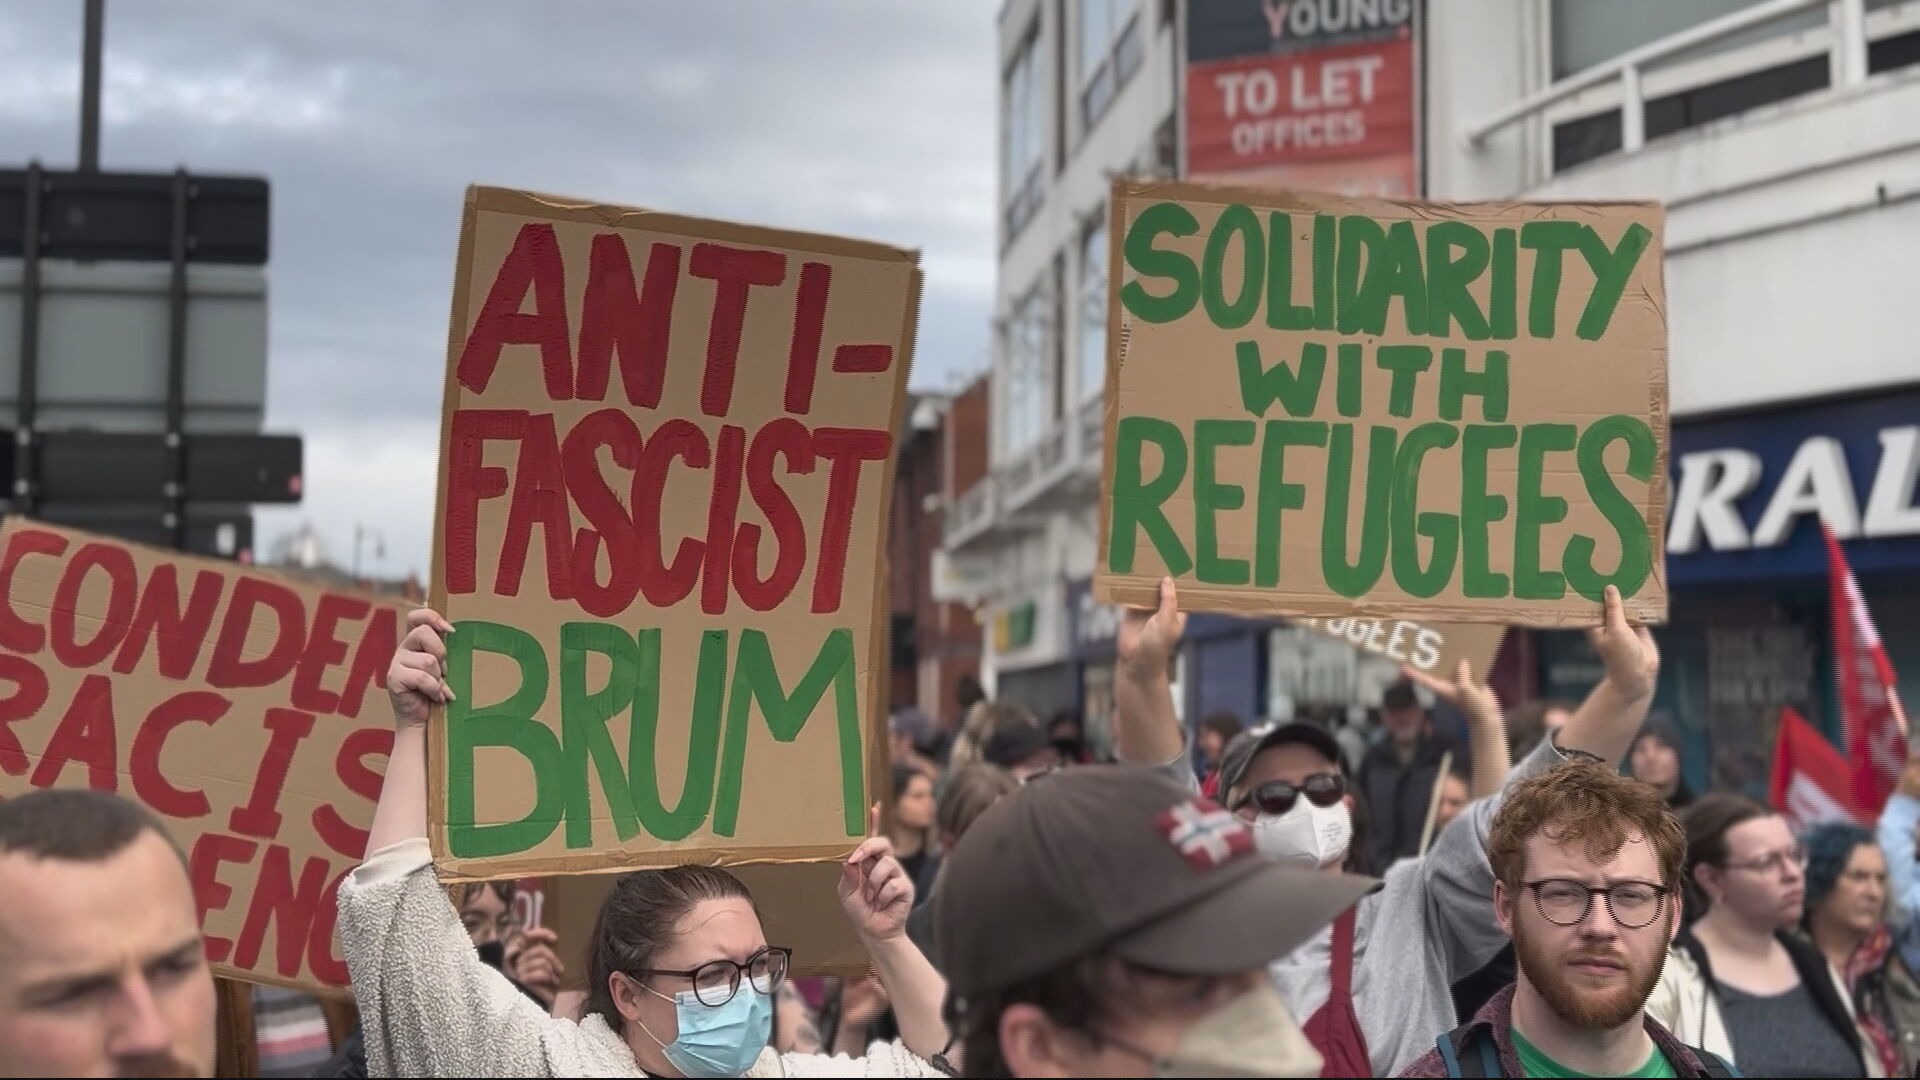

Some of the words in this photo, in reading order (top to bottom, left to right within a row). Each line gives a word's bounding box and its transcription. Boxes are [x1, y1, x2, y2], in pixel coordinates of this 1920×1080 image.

[1216, 70, 1278, 118] TO
[1291, 55, 1383, 110] LET
[1231, 111, 1365, 155] OFFICES
[456, 222, 893, 418] ANTI-
[1120, 201, 1653, 341] SOLIDARITY
[1236, 340, 1511, 421] WITH
[445, 408, 891, 616] FASCIST
[1109, 414, 1657, 602] REFUGEES
[1665, 425, 1920, 555] RAL
[446, 621, 864, 857] BRUM
